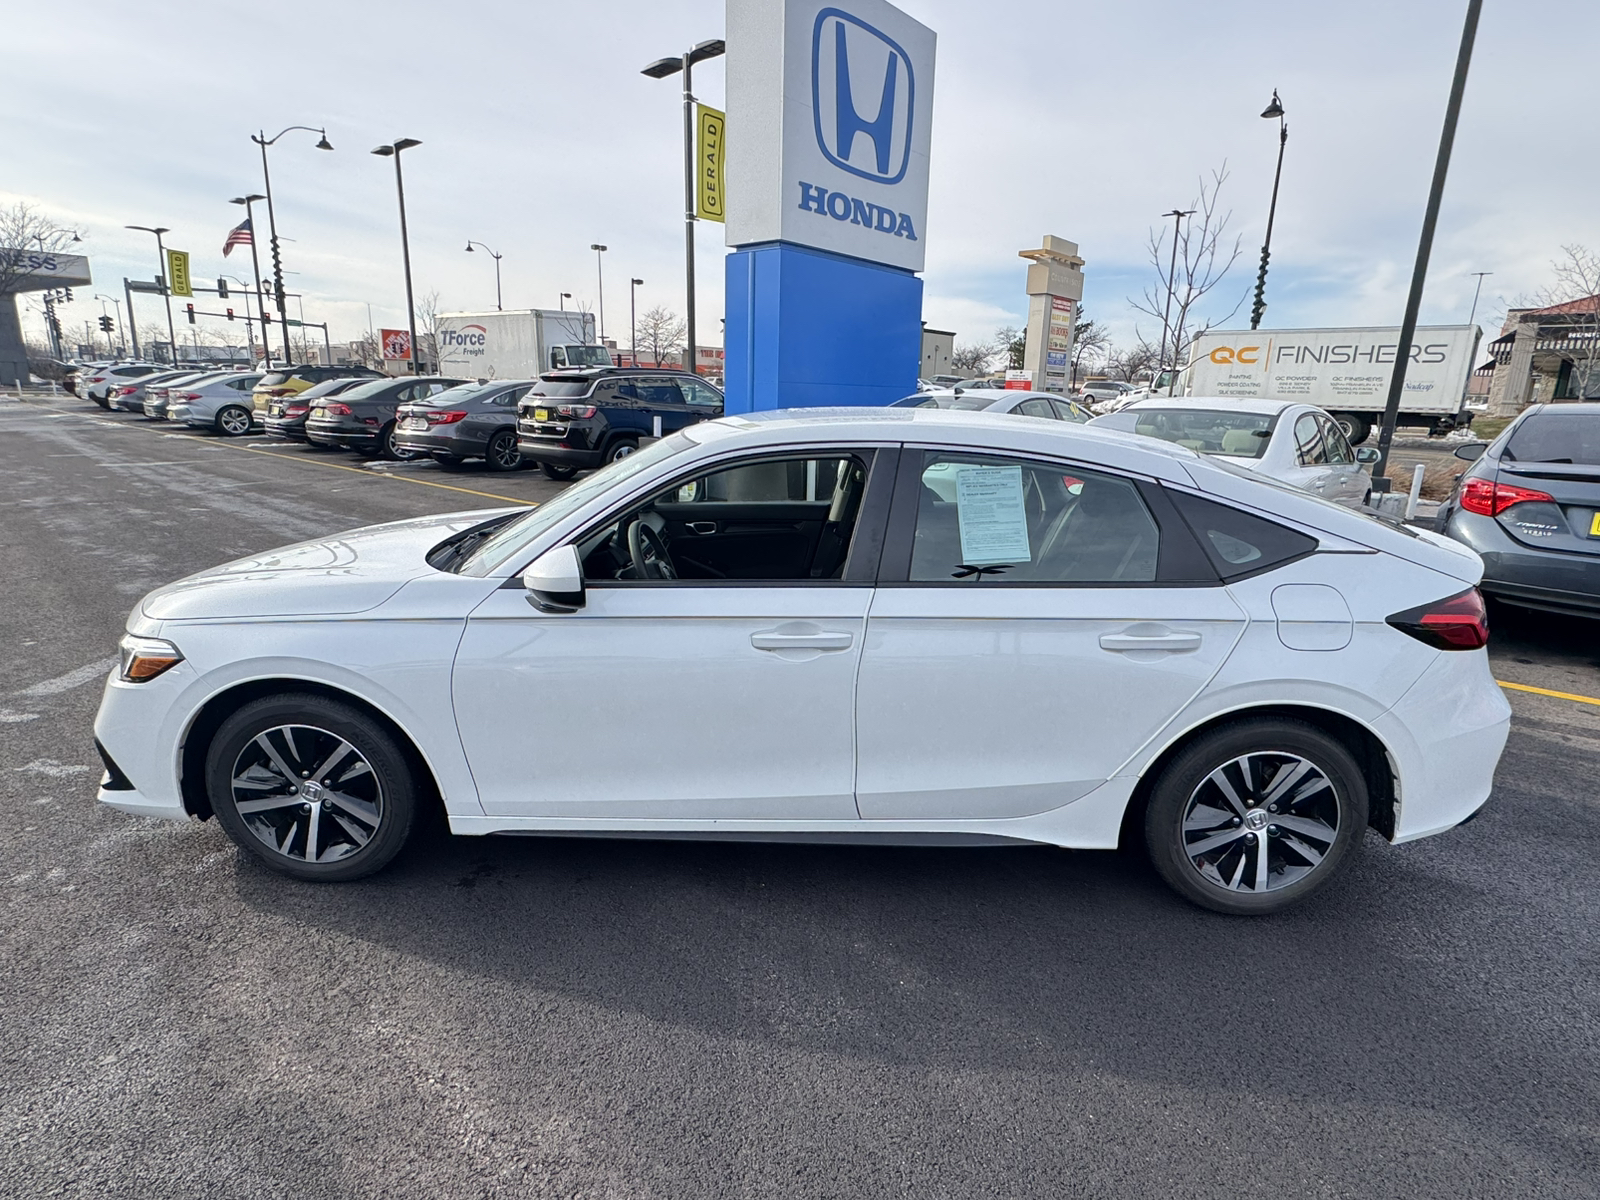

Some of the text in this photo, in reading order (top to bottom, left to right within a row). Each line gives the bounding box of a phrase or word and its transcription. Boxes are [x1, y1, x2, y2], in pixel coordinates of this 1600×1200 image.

[706, 123, 717, 207] GERALD
[798, 181, 918, 242] HONDA
[174, 256, 185, 291] GERALD
[441, 330, 486, 346] TForce
[462, 348, 485, 357] Freight
[1210, 343, 1448, 365] QC FINISHERS
